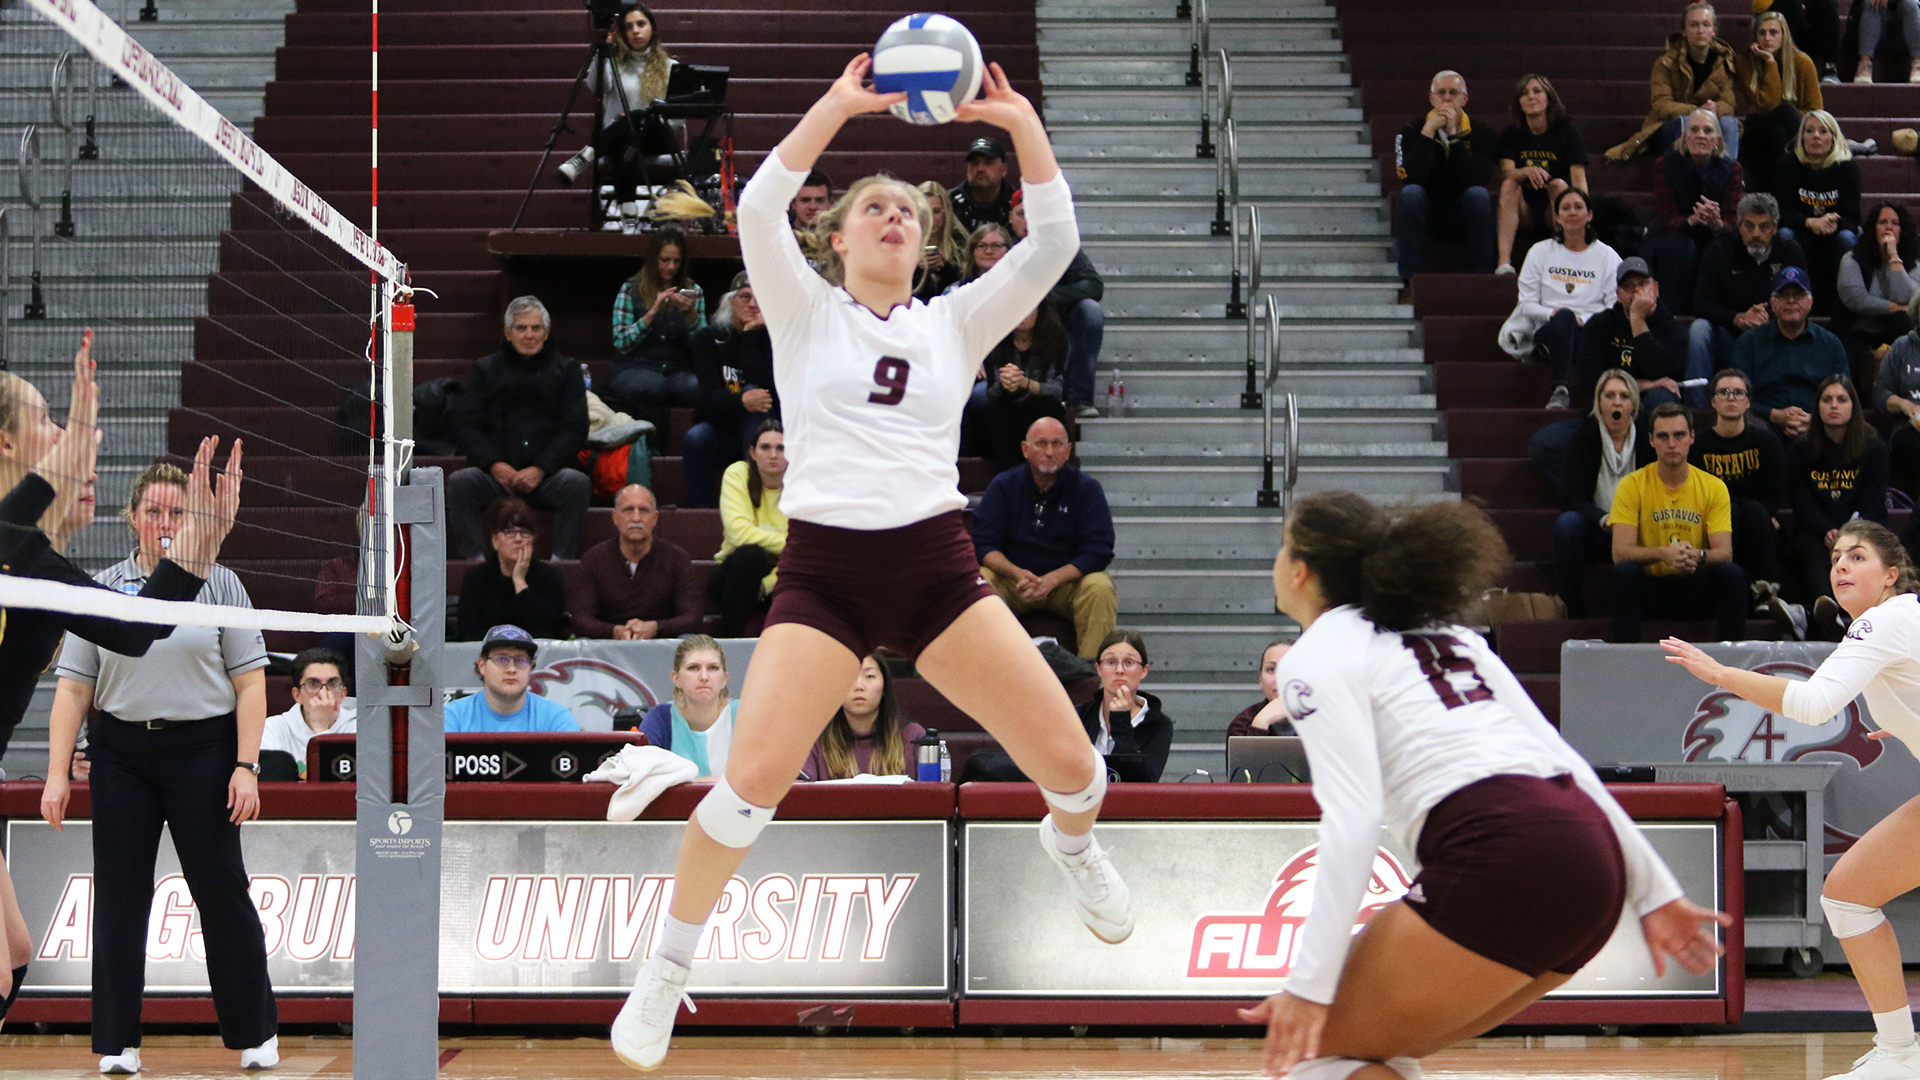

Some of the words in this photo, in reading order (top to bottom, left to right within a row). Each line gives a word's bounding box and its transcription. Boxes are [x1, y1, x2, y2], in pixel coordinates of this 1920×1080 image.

[1548, 266, 1596, 278] GUSTAVUS
[1550, 274, 1592, 284] VOLLEYBALL
[867, 355, 911, 406] 9
[1652, 508, 1702, 525] GUSTAVUS
[339, 759, 351, 774] B
[455, 754, 501, 776] POSS
[559, 758, 572, 773] B
[369, 837, 397, 847] SPORTS
[398, 837, 431, 847] IMPORTS
[472, 873, 920, 963] UNIVRSITY
